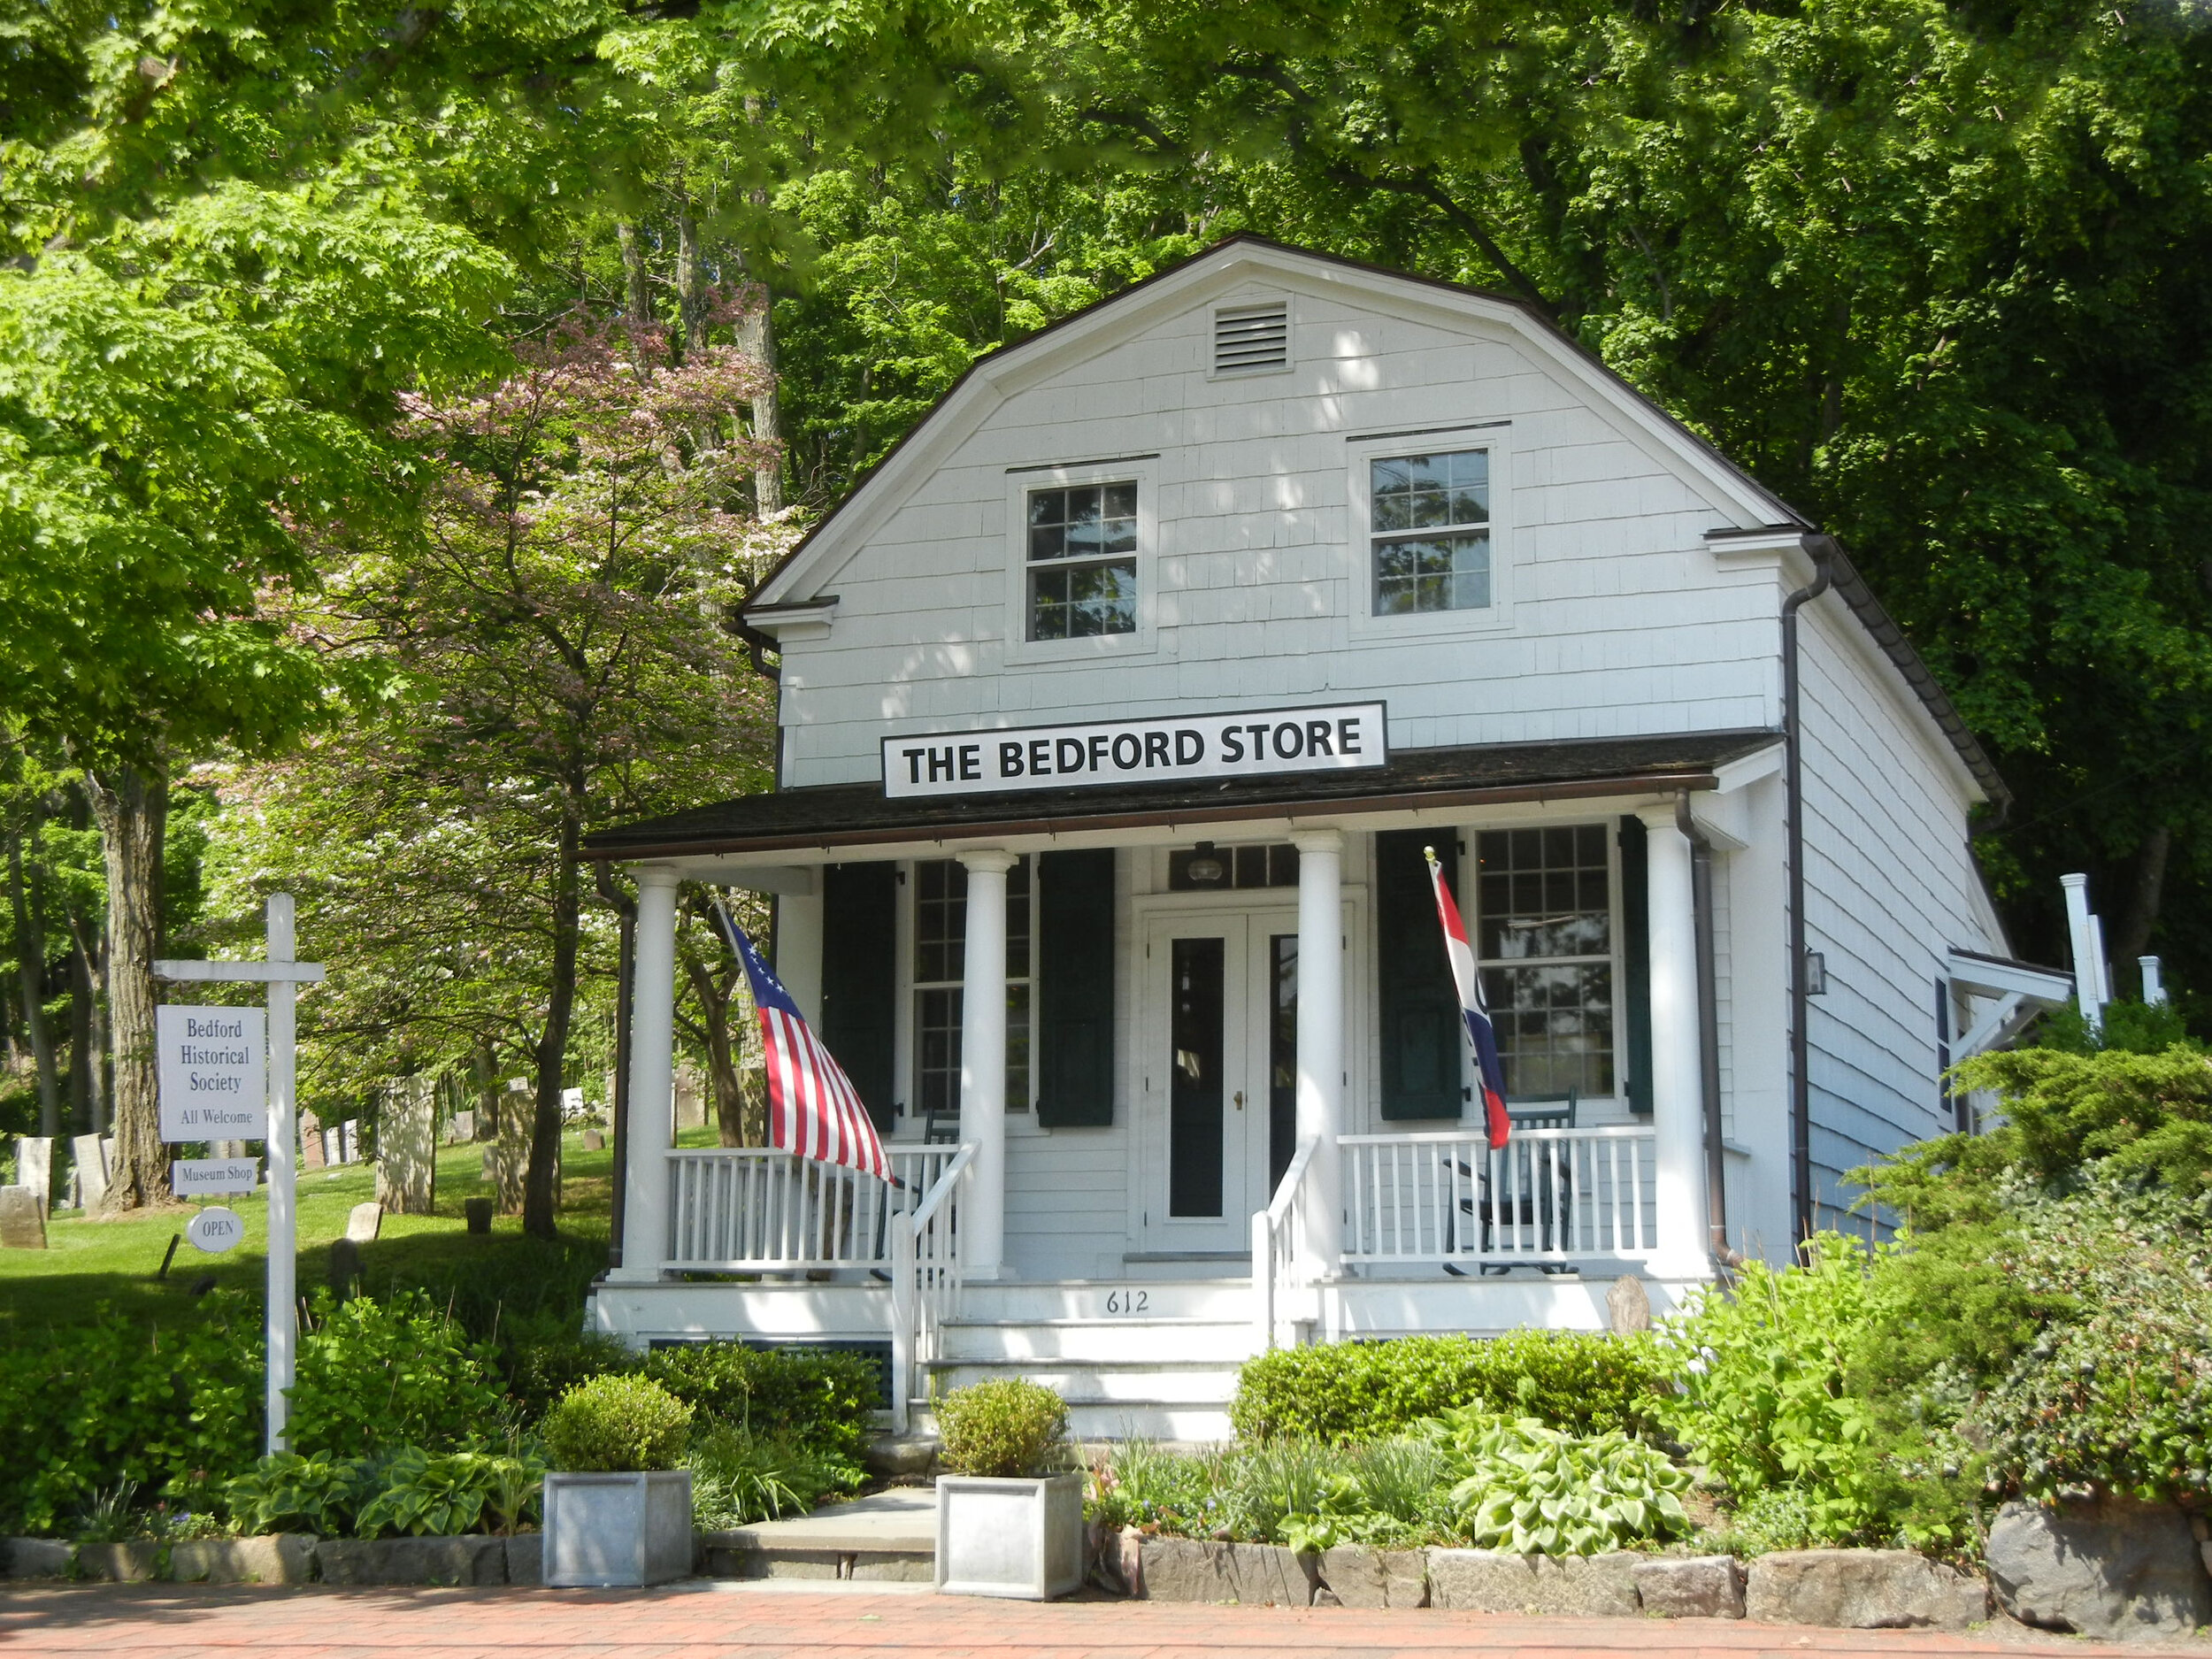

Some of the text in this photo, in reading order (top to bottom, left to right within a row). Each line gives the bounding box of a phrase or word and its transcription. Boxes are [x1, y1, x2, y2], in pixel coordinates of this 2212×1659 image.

[902, 718, 1362, 784] THE BEDFORD STORE
[187, 1018, 242, 1038] Bedford
[180, 1045, 250, 1064] Historical
[190, 1071, 242, 1094] Society
[180, 1109, 253, 1125] All Welcome
[182, 1165, 253, 1182] Museum Shop
[203, 1219, 234, 1237] OPEN
[1107, 1290, 1148, 1314] 612
